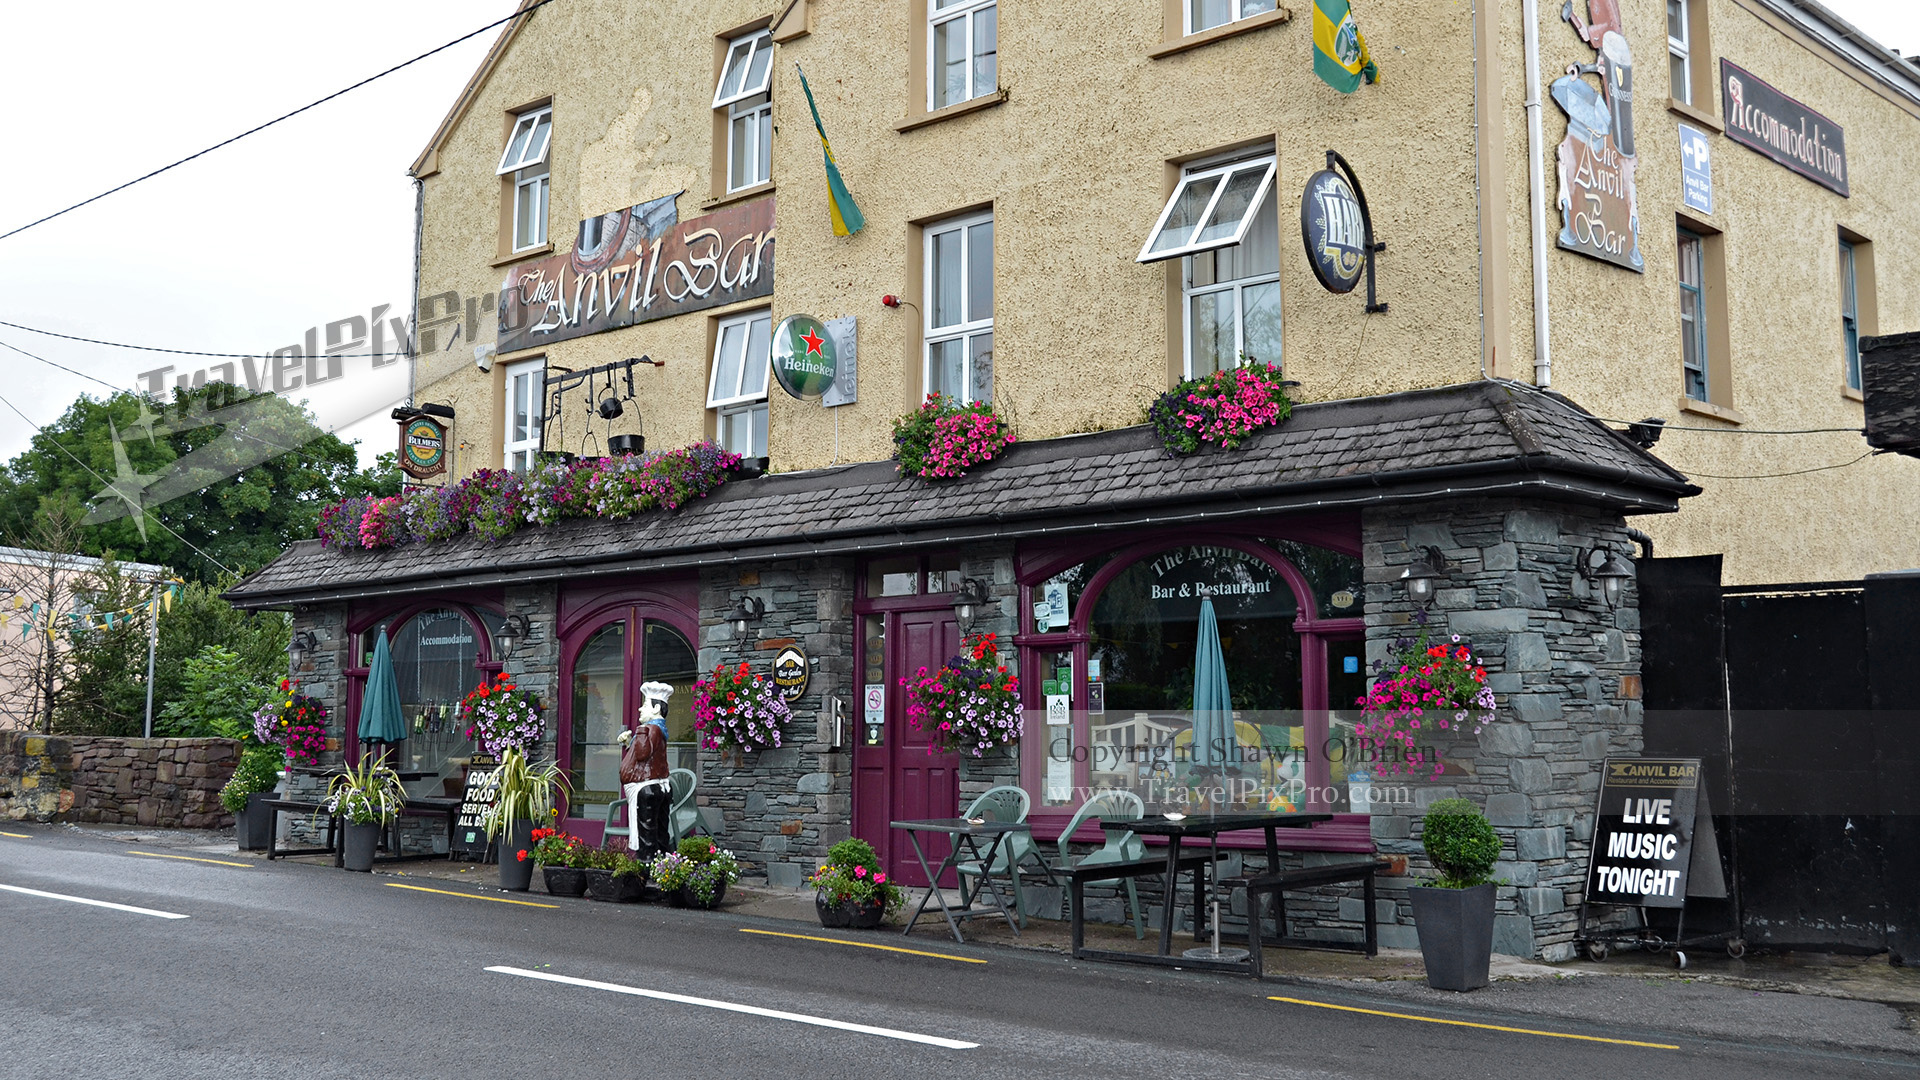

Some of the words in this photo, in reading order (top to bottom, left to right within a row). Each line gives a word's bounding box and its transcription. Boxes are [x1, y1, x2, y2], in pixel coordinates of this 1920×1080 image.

[1728, 75, 1843, 182] Accommodation
[1587, 127, 1619, 169] The
[1692, 136, 1708, 171] P
[1574, 142, 1624, 199] Anvil
[1574, 192, 1626, 255] Bar
[663, 227, 775, 301] Bar
[517, 269, 555, 304] The
[529, 237, 663, 333] Anvil
[784, 357, 835, 378] Heineken
[408, 435, 441, 448] BULMERS
[404, 458, 413, 469] ON
[413, 462, 442, 474] DRAUGHT
[1150, 552, 1185, 577] The
[1188, 545, 1233, 561] Anvil
[1151, 584, 1176, 599] Bar
[1178, 582, 1192, 598] &
[1195, 579, 1272, 597] Restaurant
[420, 634, 473, 646] Accommodation
[469, 771, 500, 786] GOOD
[1628, 766, 1666, 777] ANVIL
[1669, 766, 1695, 777] BAR
[465, 788, 495, 802] FOOD
[457, 815, 473, 826] ALL
[1622, 798, 1672, 825] LIVE
[1607, 831, 1678, 861] MUSIC
[1597, 866, 1681, 897] TONIGHT
